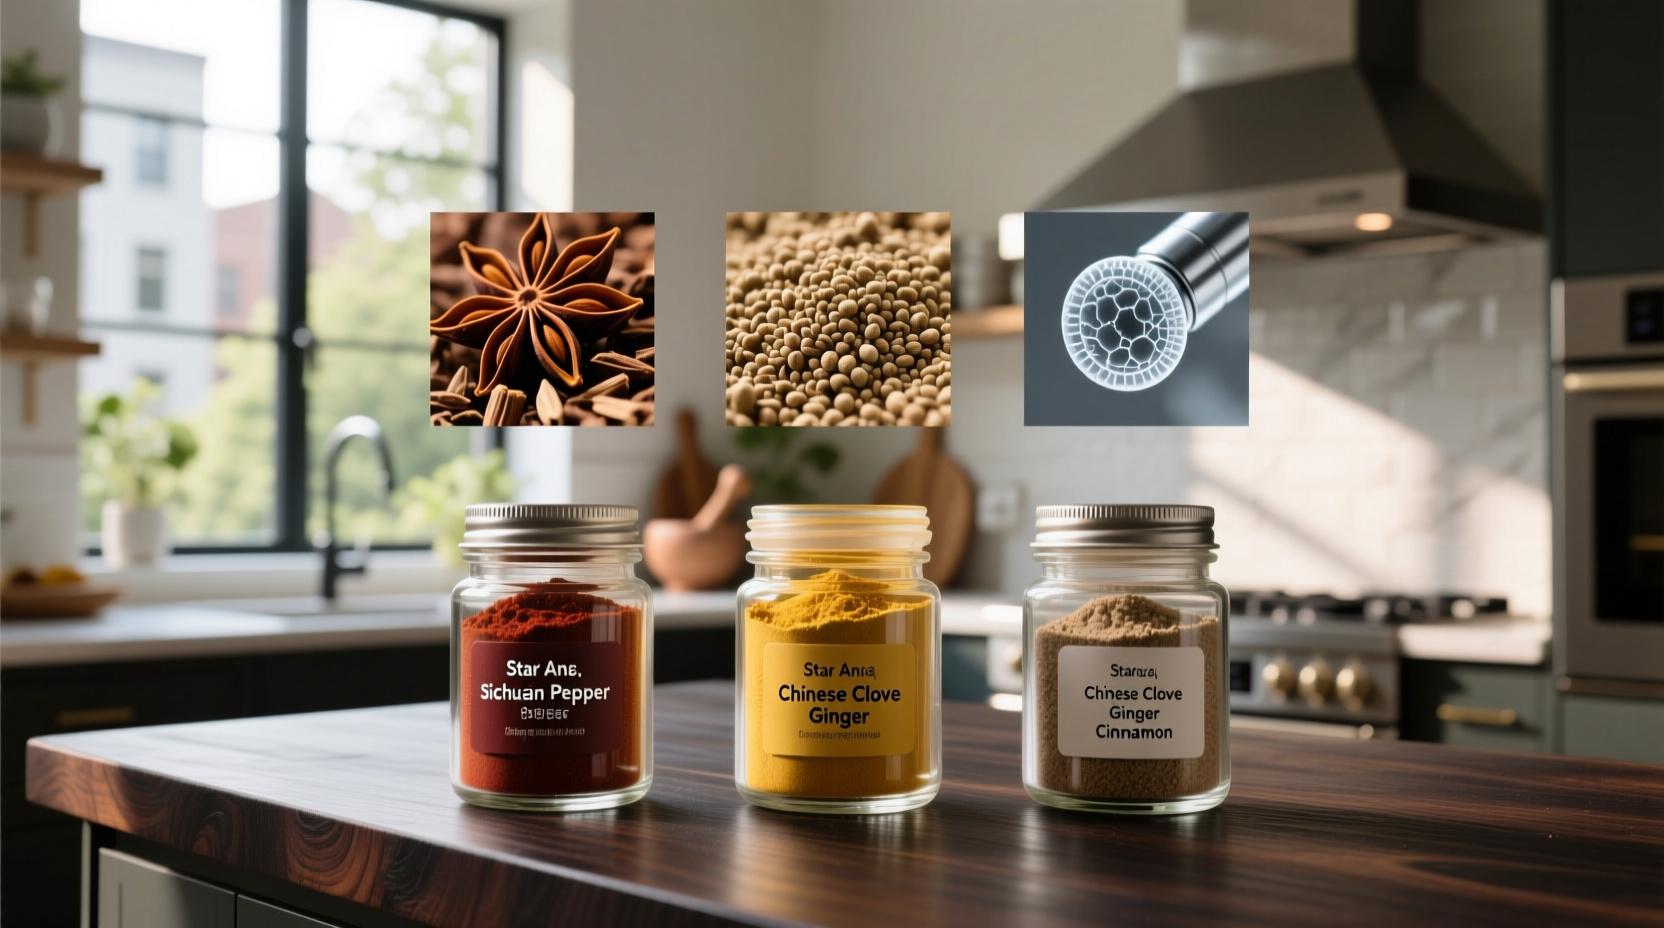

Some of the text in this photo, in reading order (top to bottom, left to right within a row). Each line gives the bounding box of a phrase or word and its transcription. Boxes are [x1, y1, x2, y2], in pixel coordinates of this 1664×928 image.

[506, 659, 540, 677] Star
[803, 662, 835, 677] Star
[480, 683, 610, 705] Sichuan Pepper
[778, 684, 901, 702] Chinese Clove
[1143, 686, 1183, 700] Clove
[809, 707, 870, 729] Ginger
[1109, 705, 1160, 723] Ginger
[1096, 724, 1173, 739] Cinnamon
